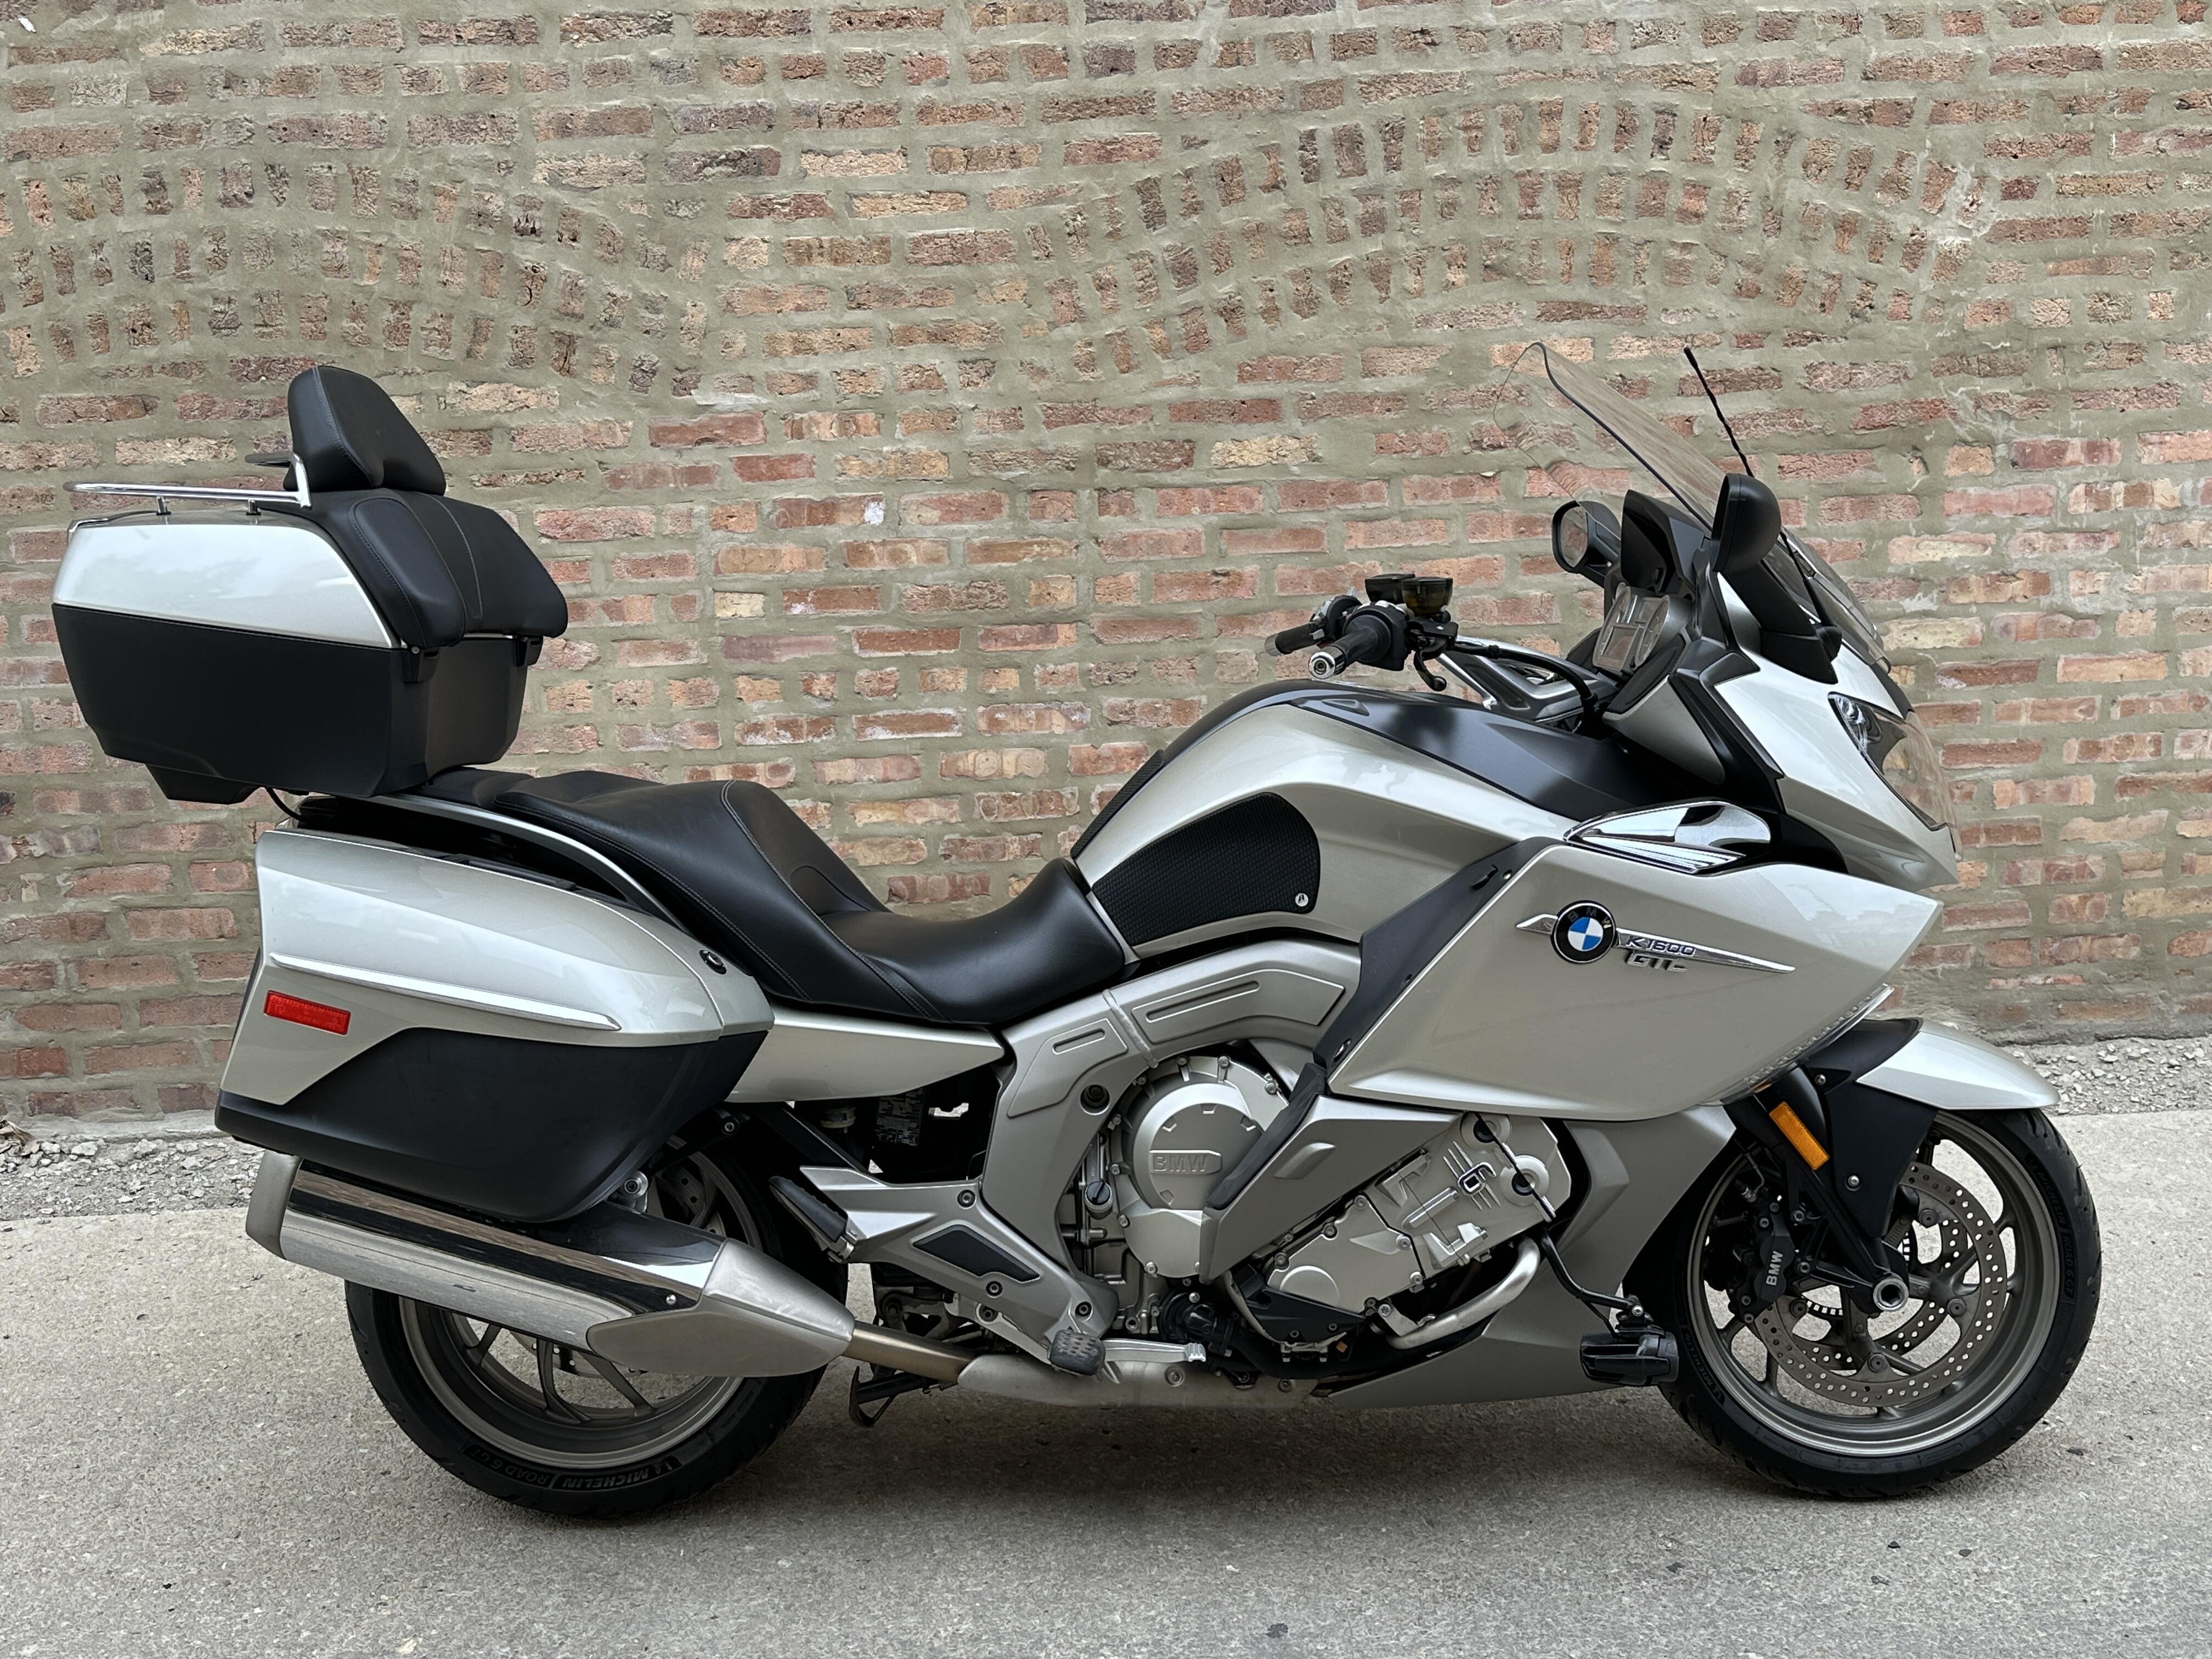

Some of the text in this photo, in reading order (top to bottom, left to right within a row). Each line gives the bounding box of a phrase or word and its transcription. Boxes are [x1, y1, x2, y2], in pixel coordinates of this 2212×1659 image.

[1567, 906, 1612, 929] BMW
[1627, 952, 1688, 973] GTL
[1153, 1154, 1207, 1172] BMW
[2036, 1172, 2067, 1227] MICHELIN
[2063, 1236, 2074, 1267] ROAD
[1766, 1251, 1783, 1285] BMW
[1685, 1333, 1714, 1385] MICHELIN
[472, 1448, 649, 1488] MICHELIN ROAD 6 GT
